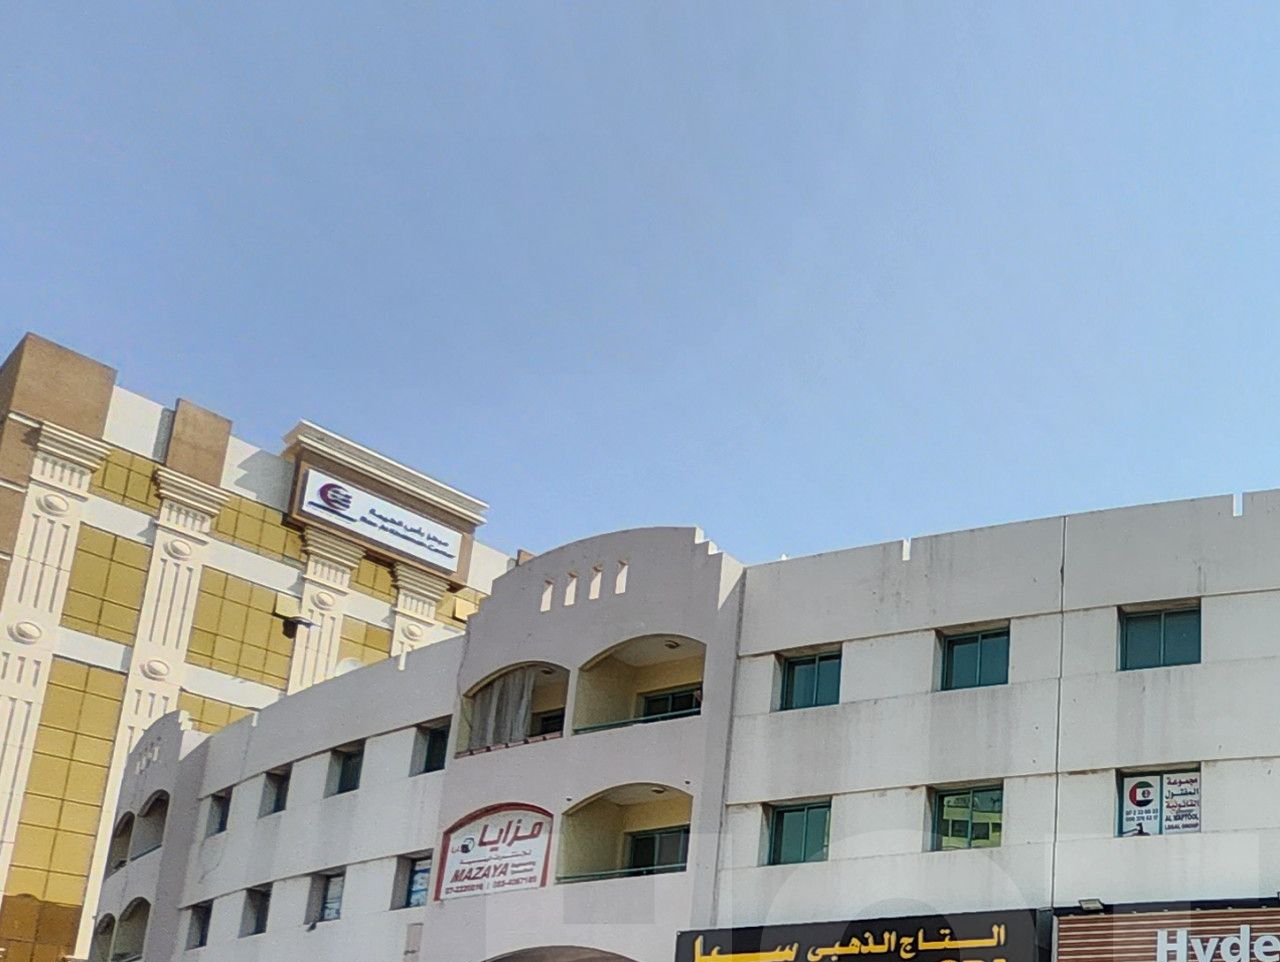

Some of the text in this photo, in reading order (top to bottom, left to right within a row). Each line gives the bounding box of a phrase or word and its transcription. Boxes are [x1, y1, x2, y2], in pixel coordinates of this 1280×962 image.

[478, 819, 544, 852] مزايا
[450, 863, 509, 883] MAZAYA
[899, 924, 1006, 960] التاج
